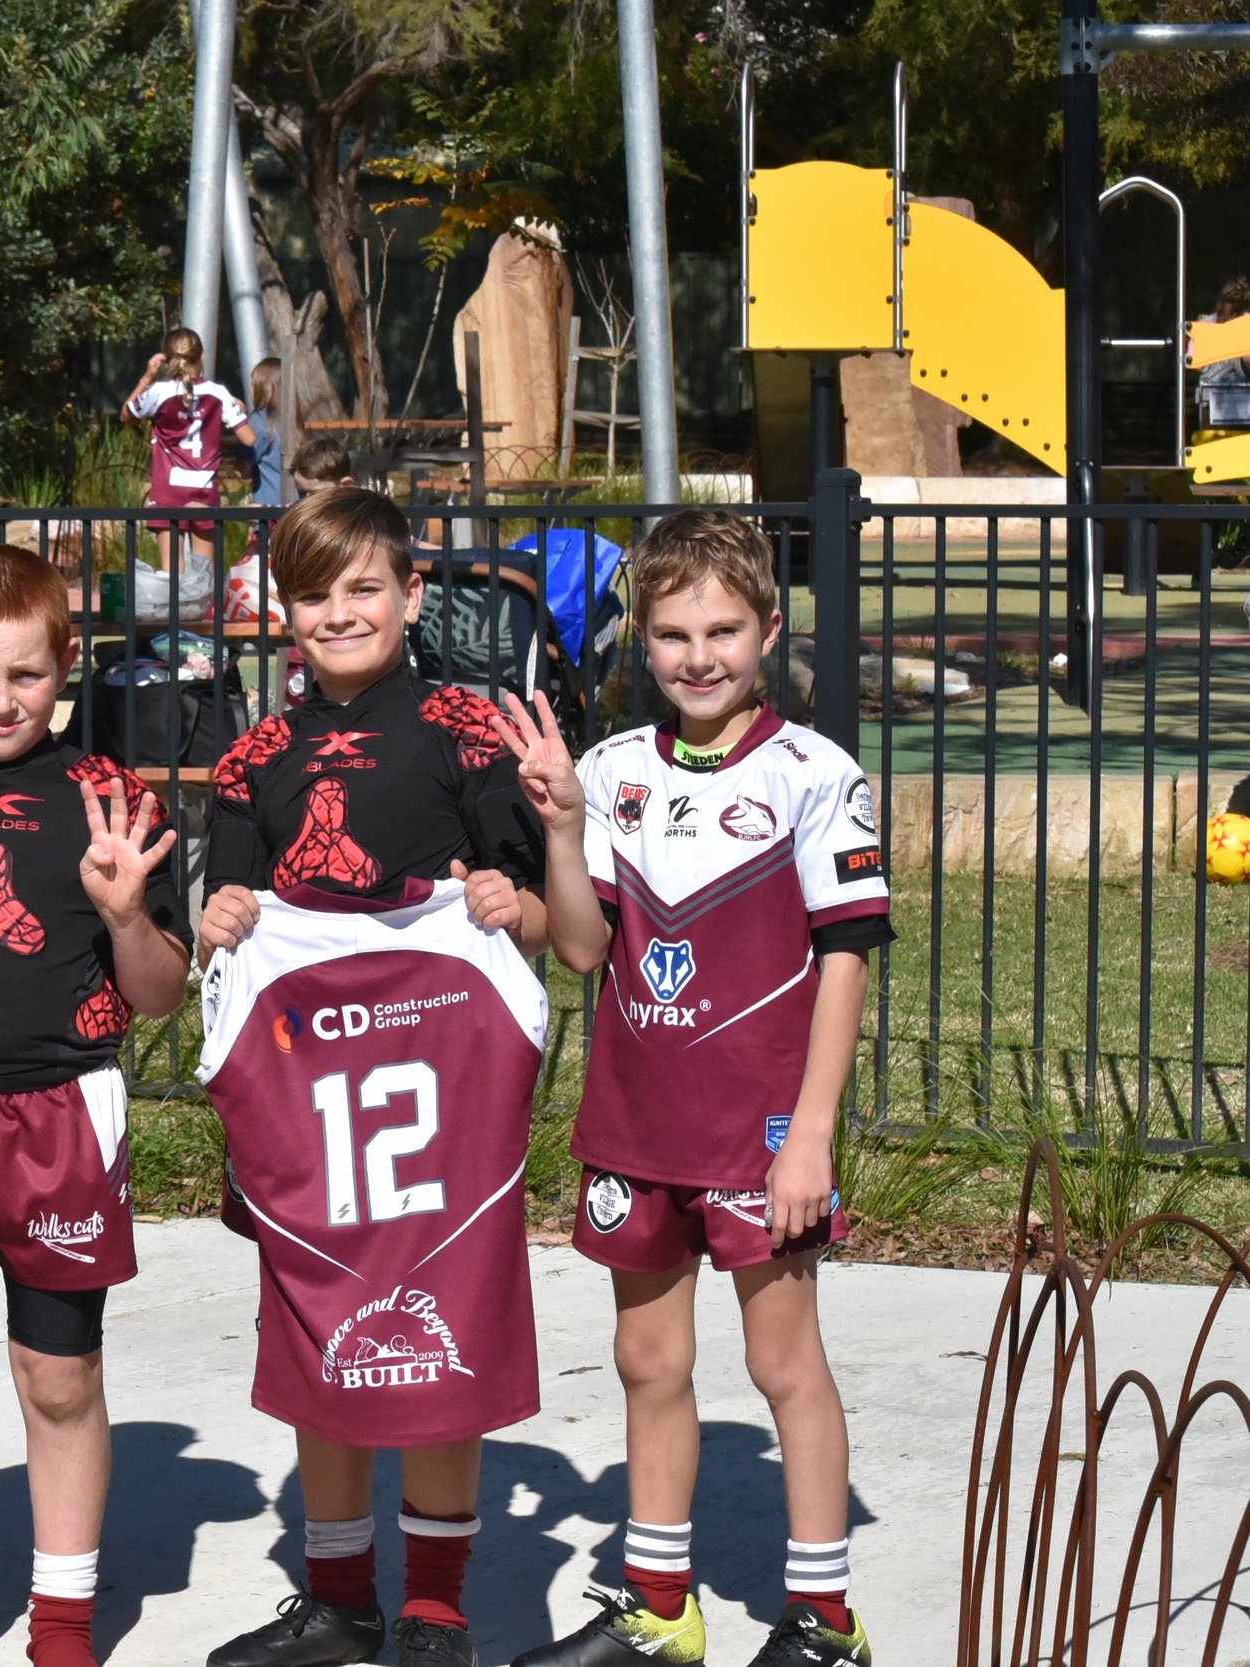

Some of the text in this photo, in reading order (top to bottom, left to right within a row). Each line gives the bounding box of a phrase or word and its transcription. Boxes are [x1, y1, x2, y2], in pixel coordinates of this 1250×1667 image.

[179, 419, 204, 459] 4
[302, 759, 377, 773] BLADES
[373, 990, 469, 1016] Construction
[630, 994, 697, 1028] hyrax
[311, 1003, 370, 1041] CD
[375, 1014, 421, 1030] Group
[311, 1058, 447, 1227] 12
[27, 1210, 104, 1239] Wilks cuts
[356, 1284, 403, 1322] and
[400, 1289, 475, 1379] Beyond
[336, 1350, 444, 1368] Est 2009
[340, 1360, 443, 1389] BUILT
